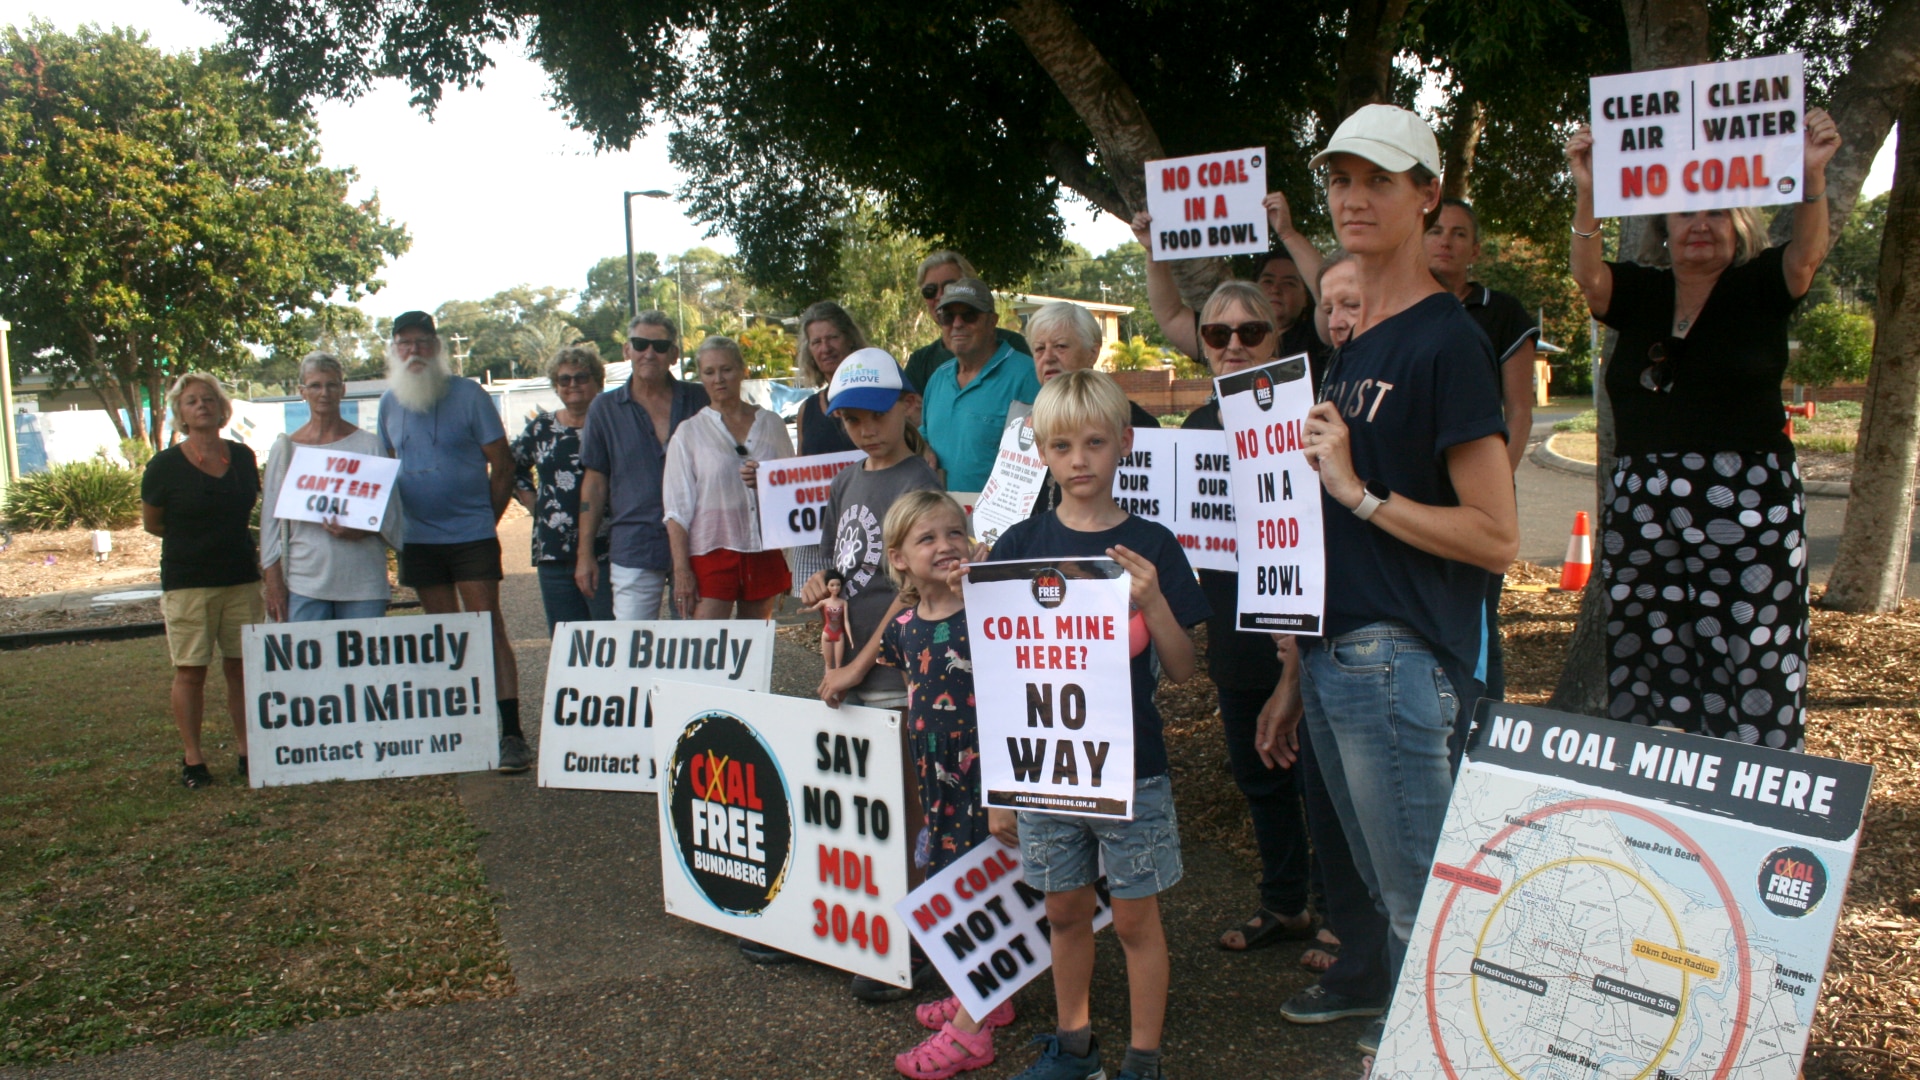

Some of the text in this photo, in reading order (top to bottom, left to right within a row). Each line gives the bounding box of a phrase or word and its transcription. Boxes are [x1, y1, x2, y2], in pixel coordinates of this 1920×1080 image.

[1603, 91, 1680, 120] CLEAR
[1708, 76, 1790, 108] CLEAN
[1621, 126, 1663, 152] AIR
[1703, 110, 1796, 142] WATER
[1162, 159, 1248, 192] NO COAL
[1621, 154, 1770, 198] NO COAL
[1184, 194, 1228, 222] IN A
[1160, 223, 1258, 250] FOOD BOWL
[1235, 419, 1304, 460] NO COAL
[326, 456, 360, 474] YOU
[1195, 454, 1230, 472] SAVE
[296, 474, 382, 499] CAN'T EAT
[1120, 474, 1148, 492] OUR
[1198, 478, 1228, 496] OUR
[1258, 470, 1293, 503] IN A
[306, 494, 350, 516] COAL
[788, 506, 829, 532] CO
[1177, 534, 1236, 552] MDL 3040
[1258, 517, 1299, 550] FOOD
[1038, 586, 1060, 596] FREE
[1258, 565, 1303, 596] BOWL
[983, 616, 1115, 640] COAL MINE
[265, 624, 468, 672] No Bundy
[568, 629, 752, 680] No Bundy
[1016, 645, 1088, 670] HERE?
[258, 676, 480, 730] Coal Mine!
[554, 686, 638, 728] Coal
[1026, 682, 1086, 730] NO
[276, 732, 462, 765] Contact your MP
[564, 752, 640, 774] Contact
[816, 732, 870, 778] SAY
[1006, 736, 1110, 788] WAY
[690, 749, 764, 811] COAL
[1488, 716, 1836, 815] NO COAL MINE HERE
[804, 785, 890, 840] NO TO
[1016, 795, 1096, 808] COALFREEBUNDABERG.COM.AU
[692, 798, 766, 863] FREE
[1625, 836, 1701, 862] Moore Park Beach
[694, 850, 766, 888] BUNDABERG
[818, 844, 878, 896] MDL
[1774, 858, 1814, 882] COAL
[912, 893, 952, 932] NO
[954, 848, 1018, 900] COAL
[1766, 893, 1807, 909] BUNDABERG
[1768, 874, 1812, 900] FREE
[813, 898, 890, 955] 3040
[942, 894, 1011, 960] NOT
[967, 934, 1035, 1000] NOT
[1592, 956, 1628, 974] Resources
[1635, 944, 1660, 958] 10km
[1661, 950, 1683, 966] Dust
[1684, 958, 1715, 975] Radius
[1474, 962, 1544, 992] Infrastructure Site
[1775, 978, 1806, 996] Heads
[1596, 978, 1656, 1006] Infrastructure
[1657, 998, 1676, 1012] Site
[1578, 1054, 1600, 1072] River
